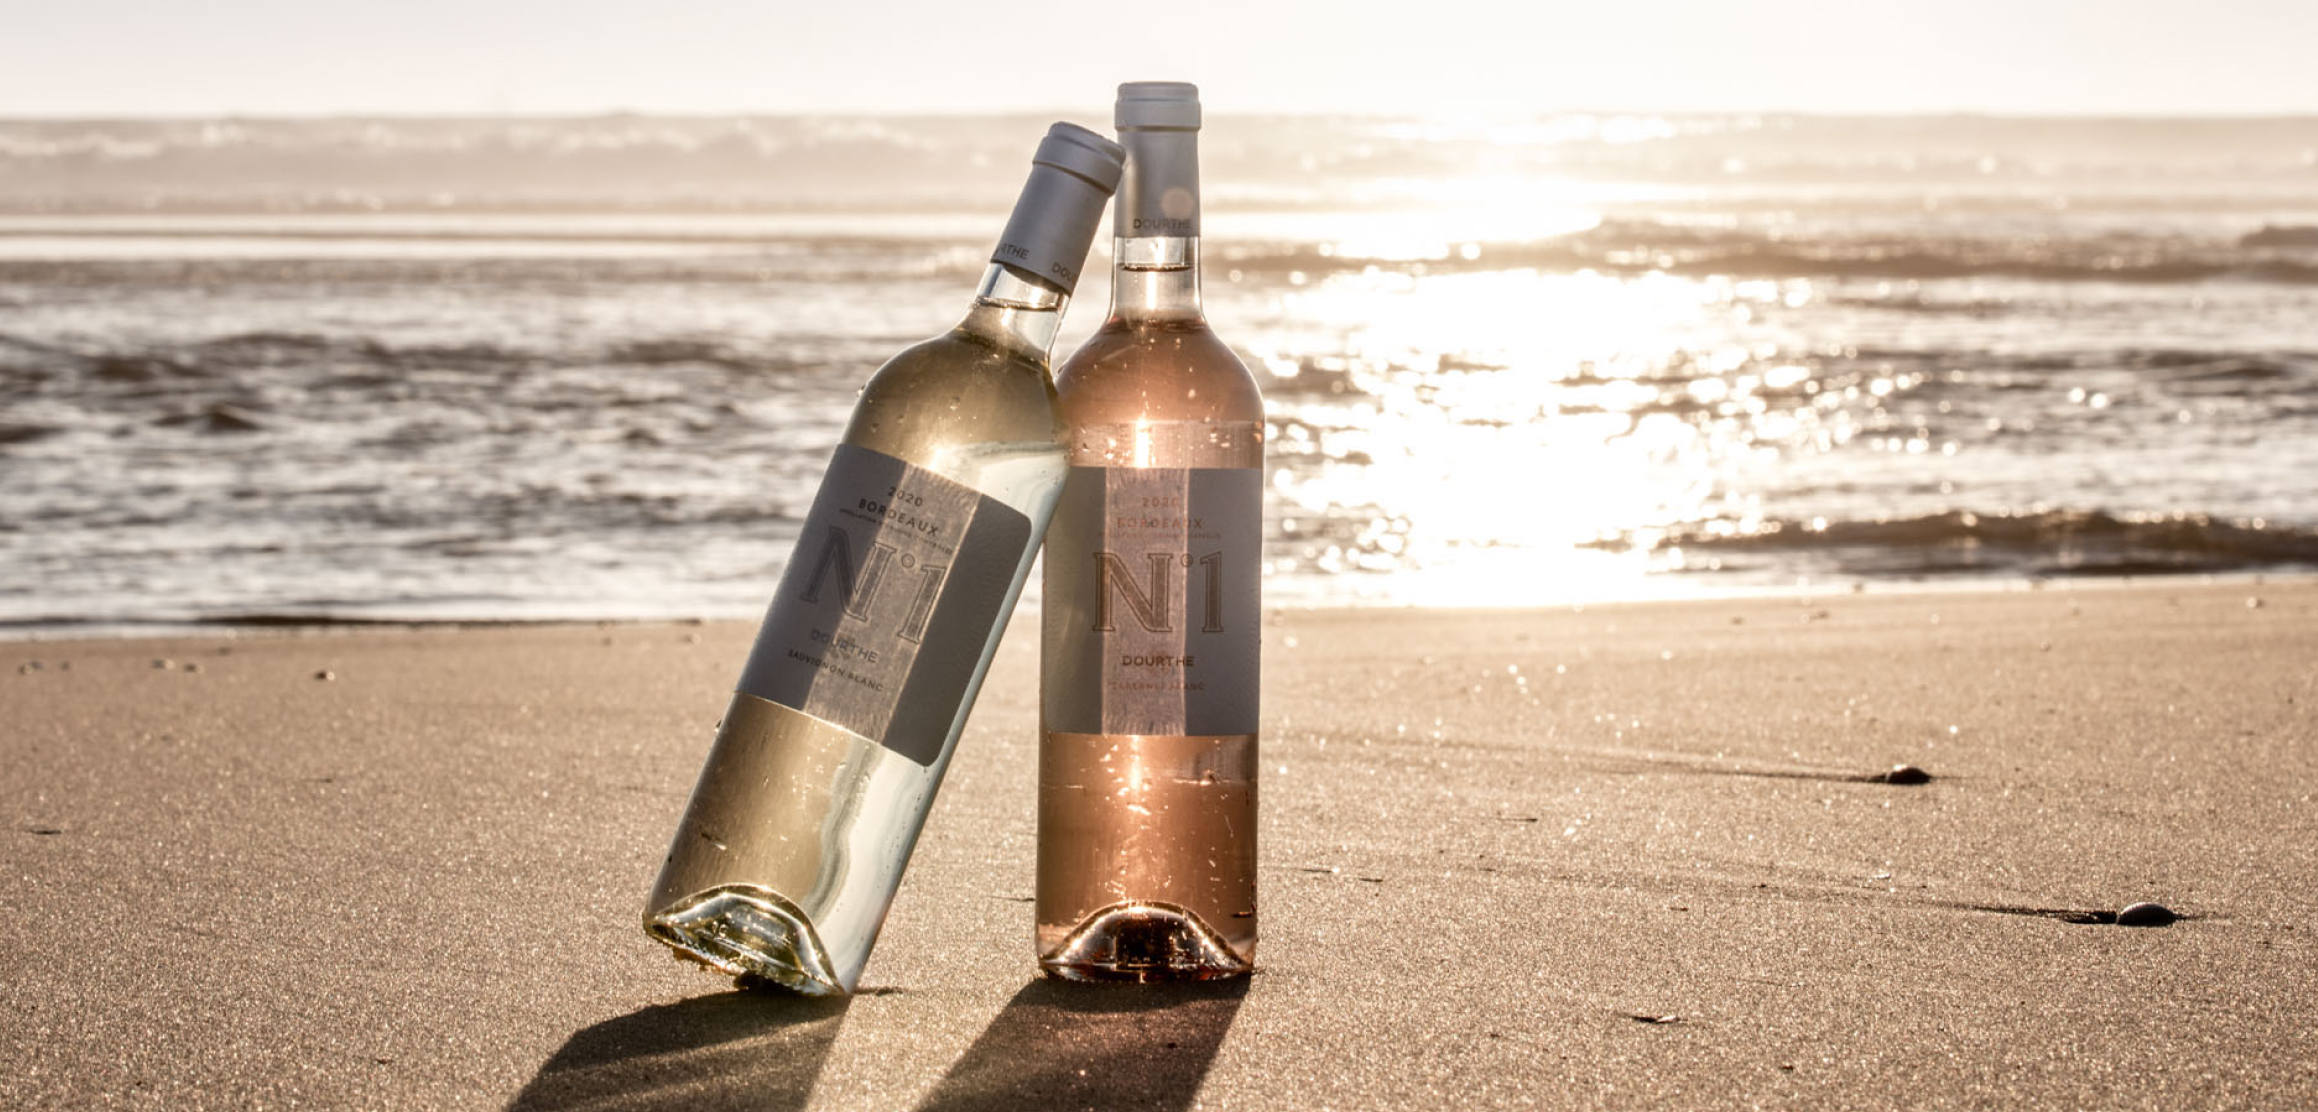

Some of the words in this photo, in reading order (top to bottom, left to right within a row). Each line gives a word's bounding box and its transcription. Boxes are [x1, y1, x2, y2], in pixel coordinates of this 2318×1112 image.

[1133, 218, 1191, 230] DOURTHE
[887, 486, 923, 507] 2020
[1142, 496, 1179, 507] 2020
[858, 498, 939, 537] BORDEAUX
[1117, 516, 1204, 529] BORDEAUX
[810, 628, 879, 664] DOURTHE
[1121, 655, 1195, 667] DOURTHE
[787, 648, 846, 677] SAUVIGNON
[848, 672, 884, 692] BLANC
